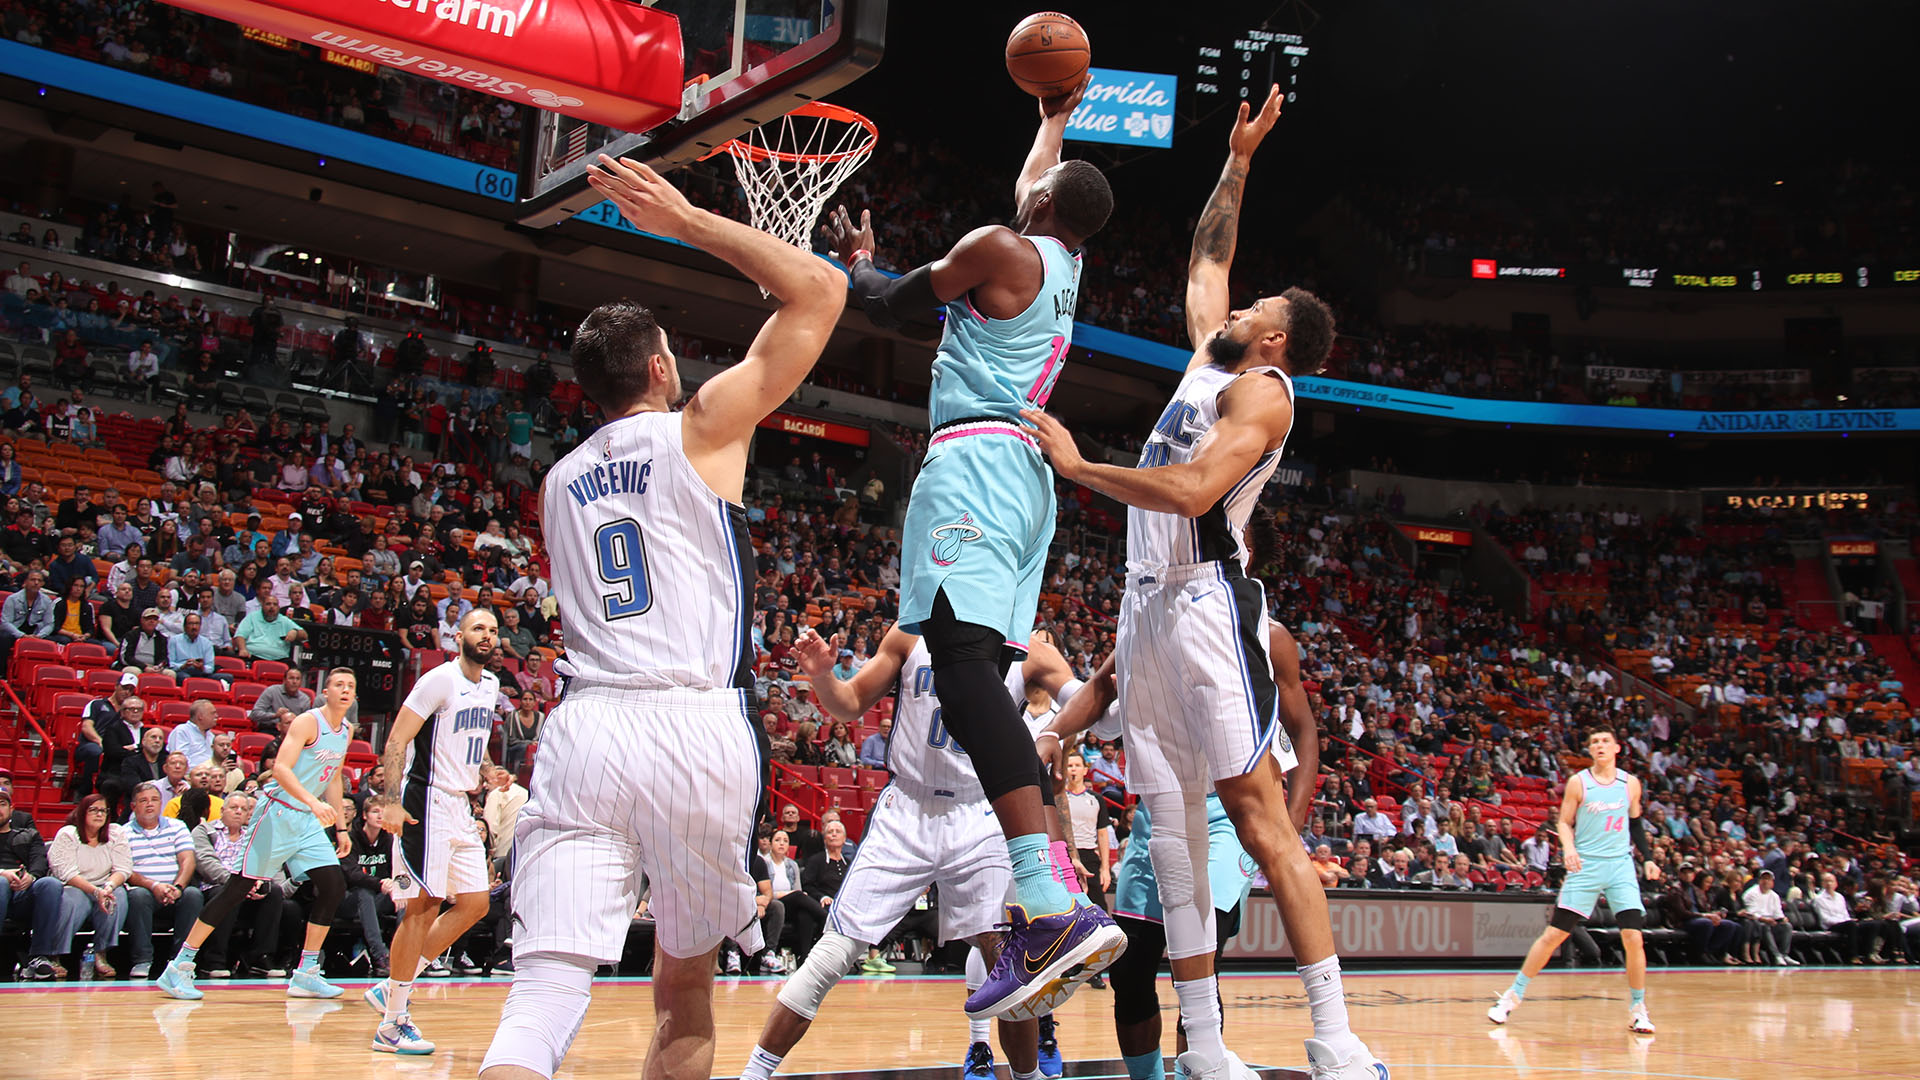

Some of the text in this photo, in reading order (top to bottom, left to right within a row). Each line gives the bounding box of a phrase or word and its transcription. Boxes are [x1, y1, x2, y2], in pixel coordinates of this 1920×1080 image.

[1248, 30, 1303, 44] TEAM STATS
[1199, 47, 1221, 58] FGM
[1234, 40, 1269, 52] HEAT
[1198, 65, 1218, 75] FGA
[1290, 74, 1297, 85] 1
[1196, 83, 1219, 93] FG%
[1623, 268, 1658, 279] HEAT
[1787, 272, 1844, 285] OFF REB
[1894, 270, 1920, 282] DEF
[1673, 274, 1738, 287] TOTAL REB
[1309, 383, 1331, 394] LAW
[1697, 412, 1791, 431] ANIDJAR
[1815, 411, 1898, 430] LEVINE
[567, 458, 654, 508] VUČEVIĆ
[594, 517, 654, 622] 9
[466, 736, 484, 766] 10
[1604, 816, 1625, 833] 14
[1333, 905, 1384, 952] FOR
[1392, 905, 1460, 952] YOU.
